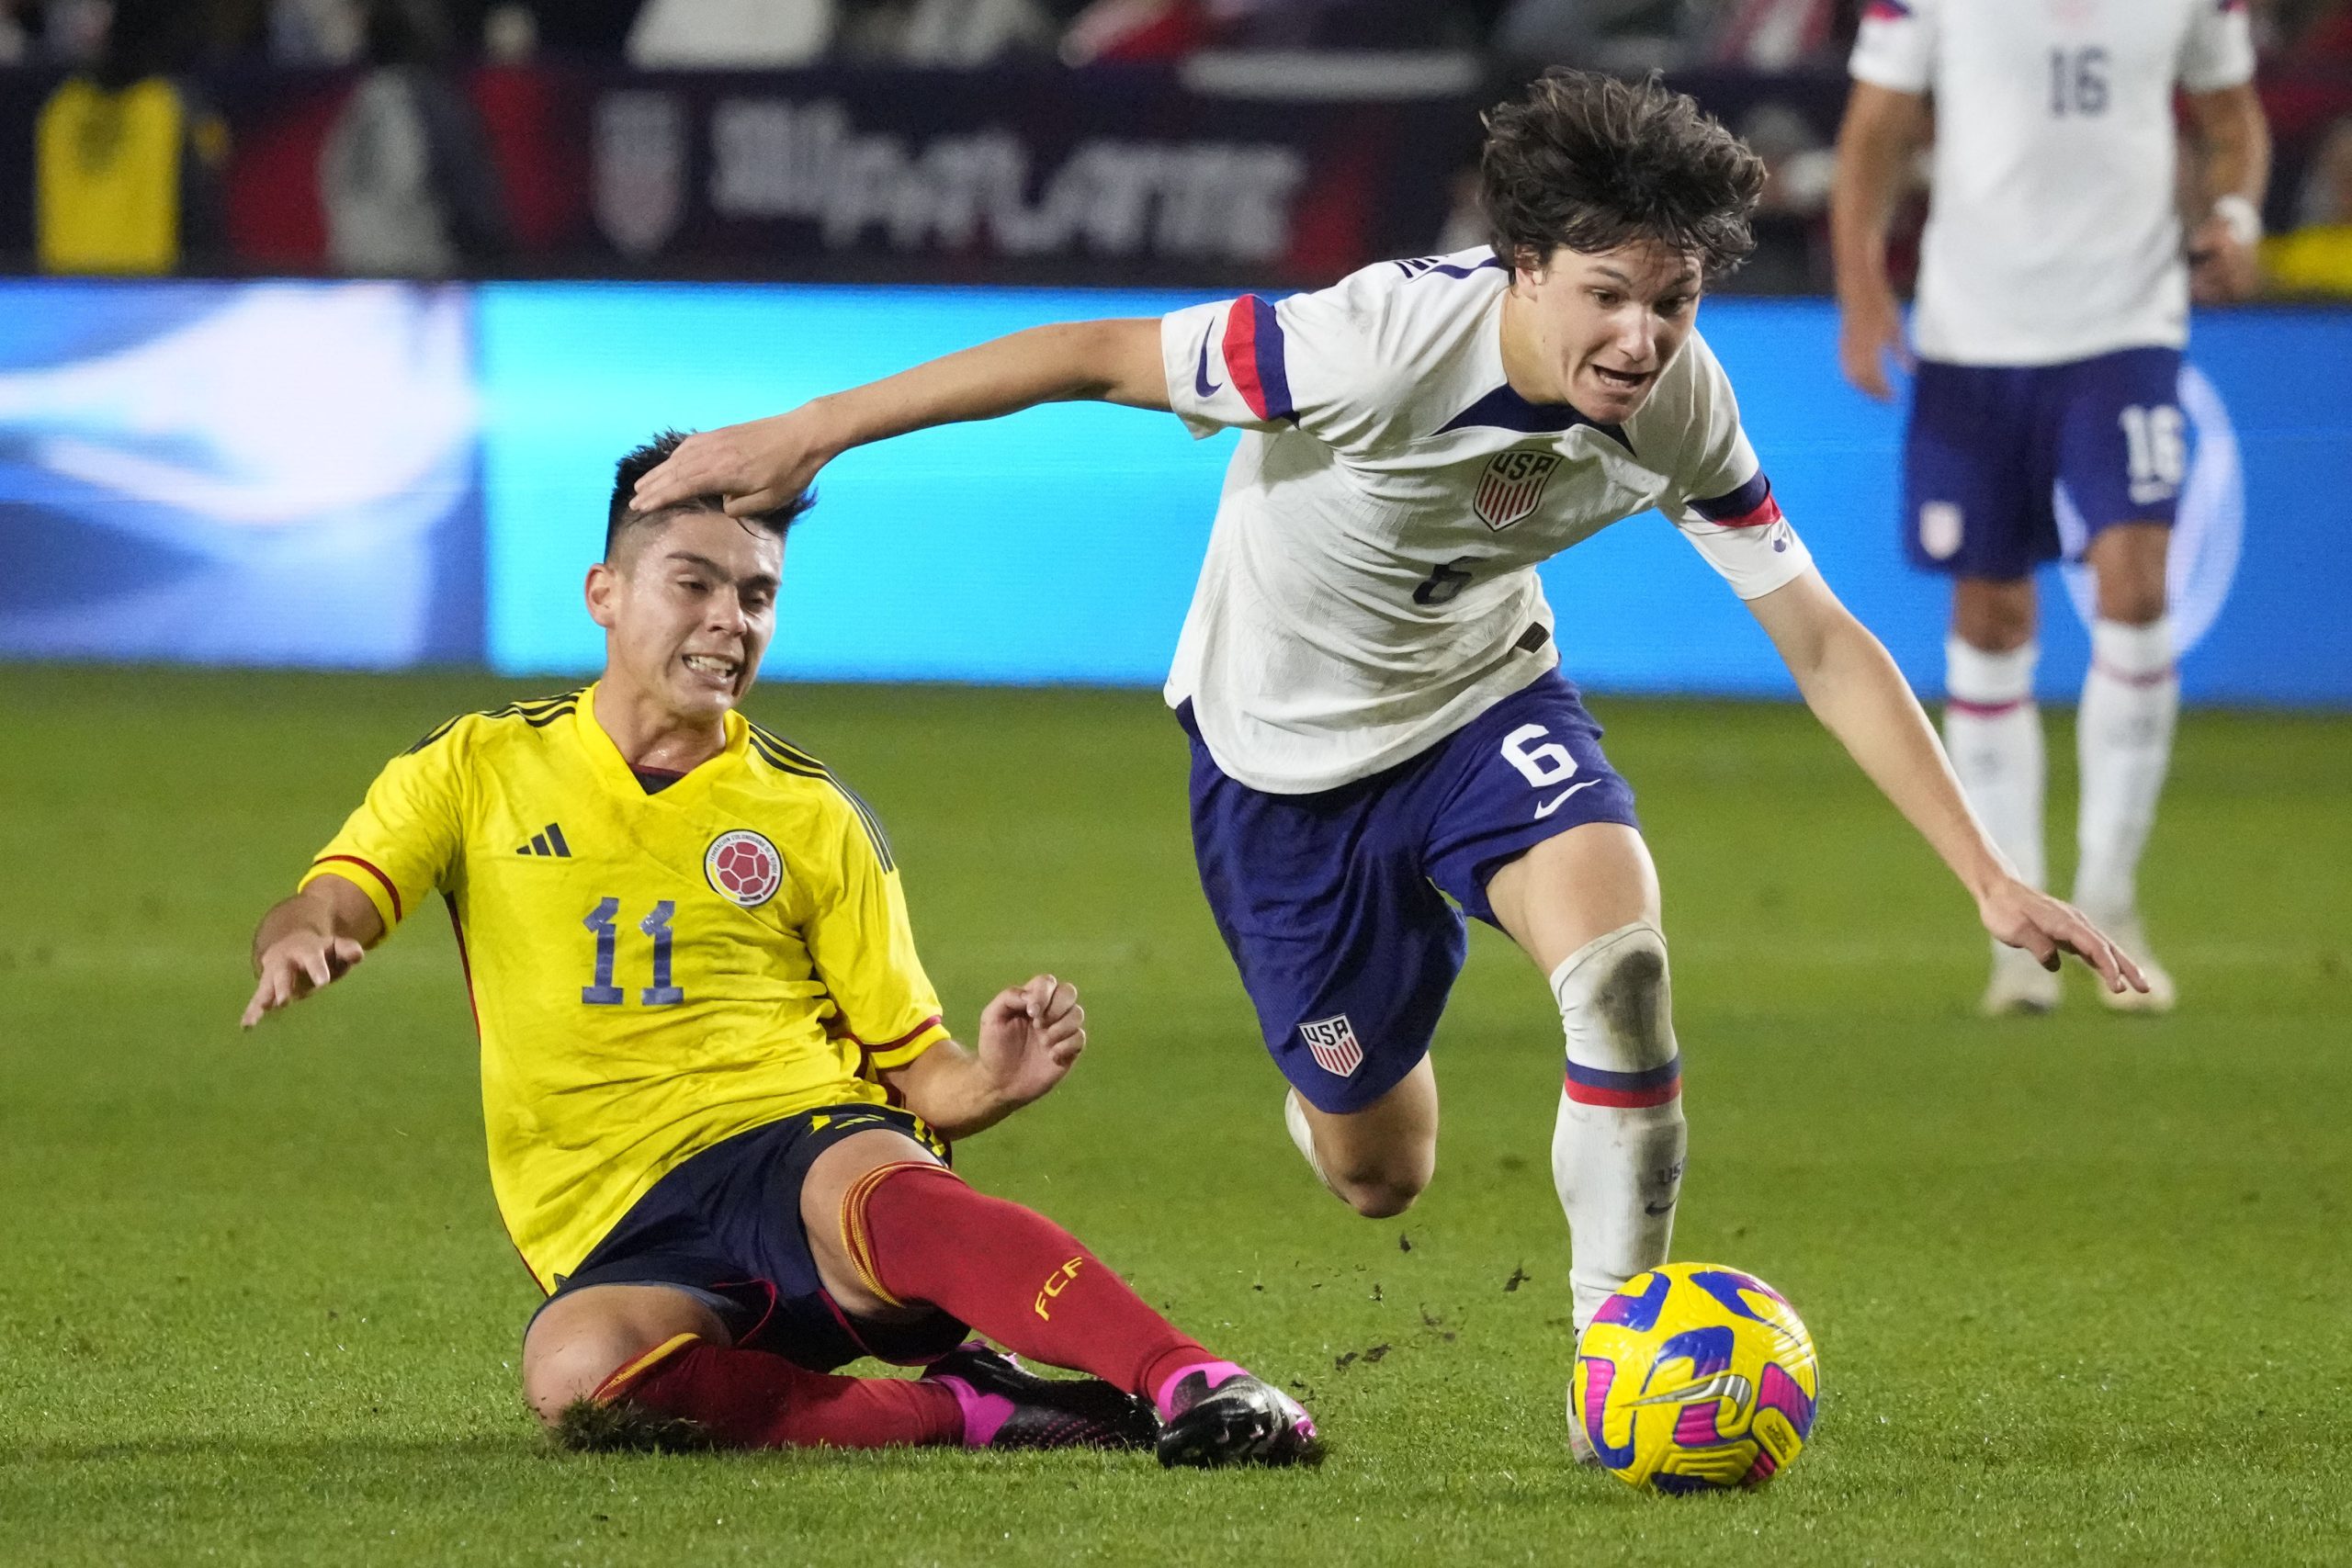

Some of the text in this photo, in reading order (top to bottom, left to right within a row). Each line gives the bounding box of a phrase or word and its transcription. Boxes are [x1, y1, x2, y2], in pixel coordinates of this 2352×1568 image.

[2050, 45, 2108, 118] 16
[1492, 453, 1555, 480] USA
[2119, 405, 2182, 485] 16
[1500, 723, 1578, 787] 6
[582, 897, 684, 1006] 11
[1303, 1019, 1349, 1046] USA
[1657, 1156, 1685, 1185] US
[1035, 1257, 1082, 1322] FCF
